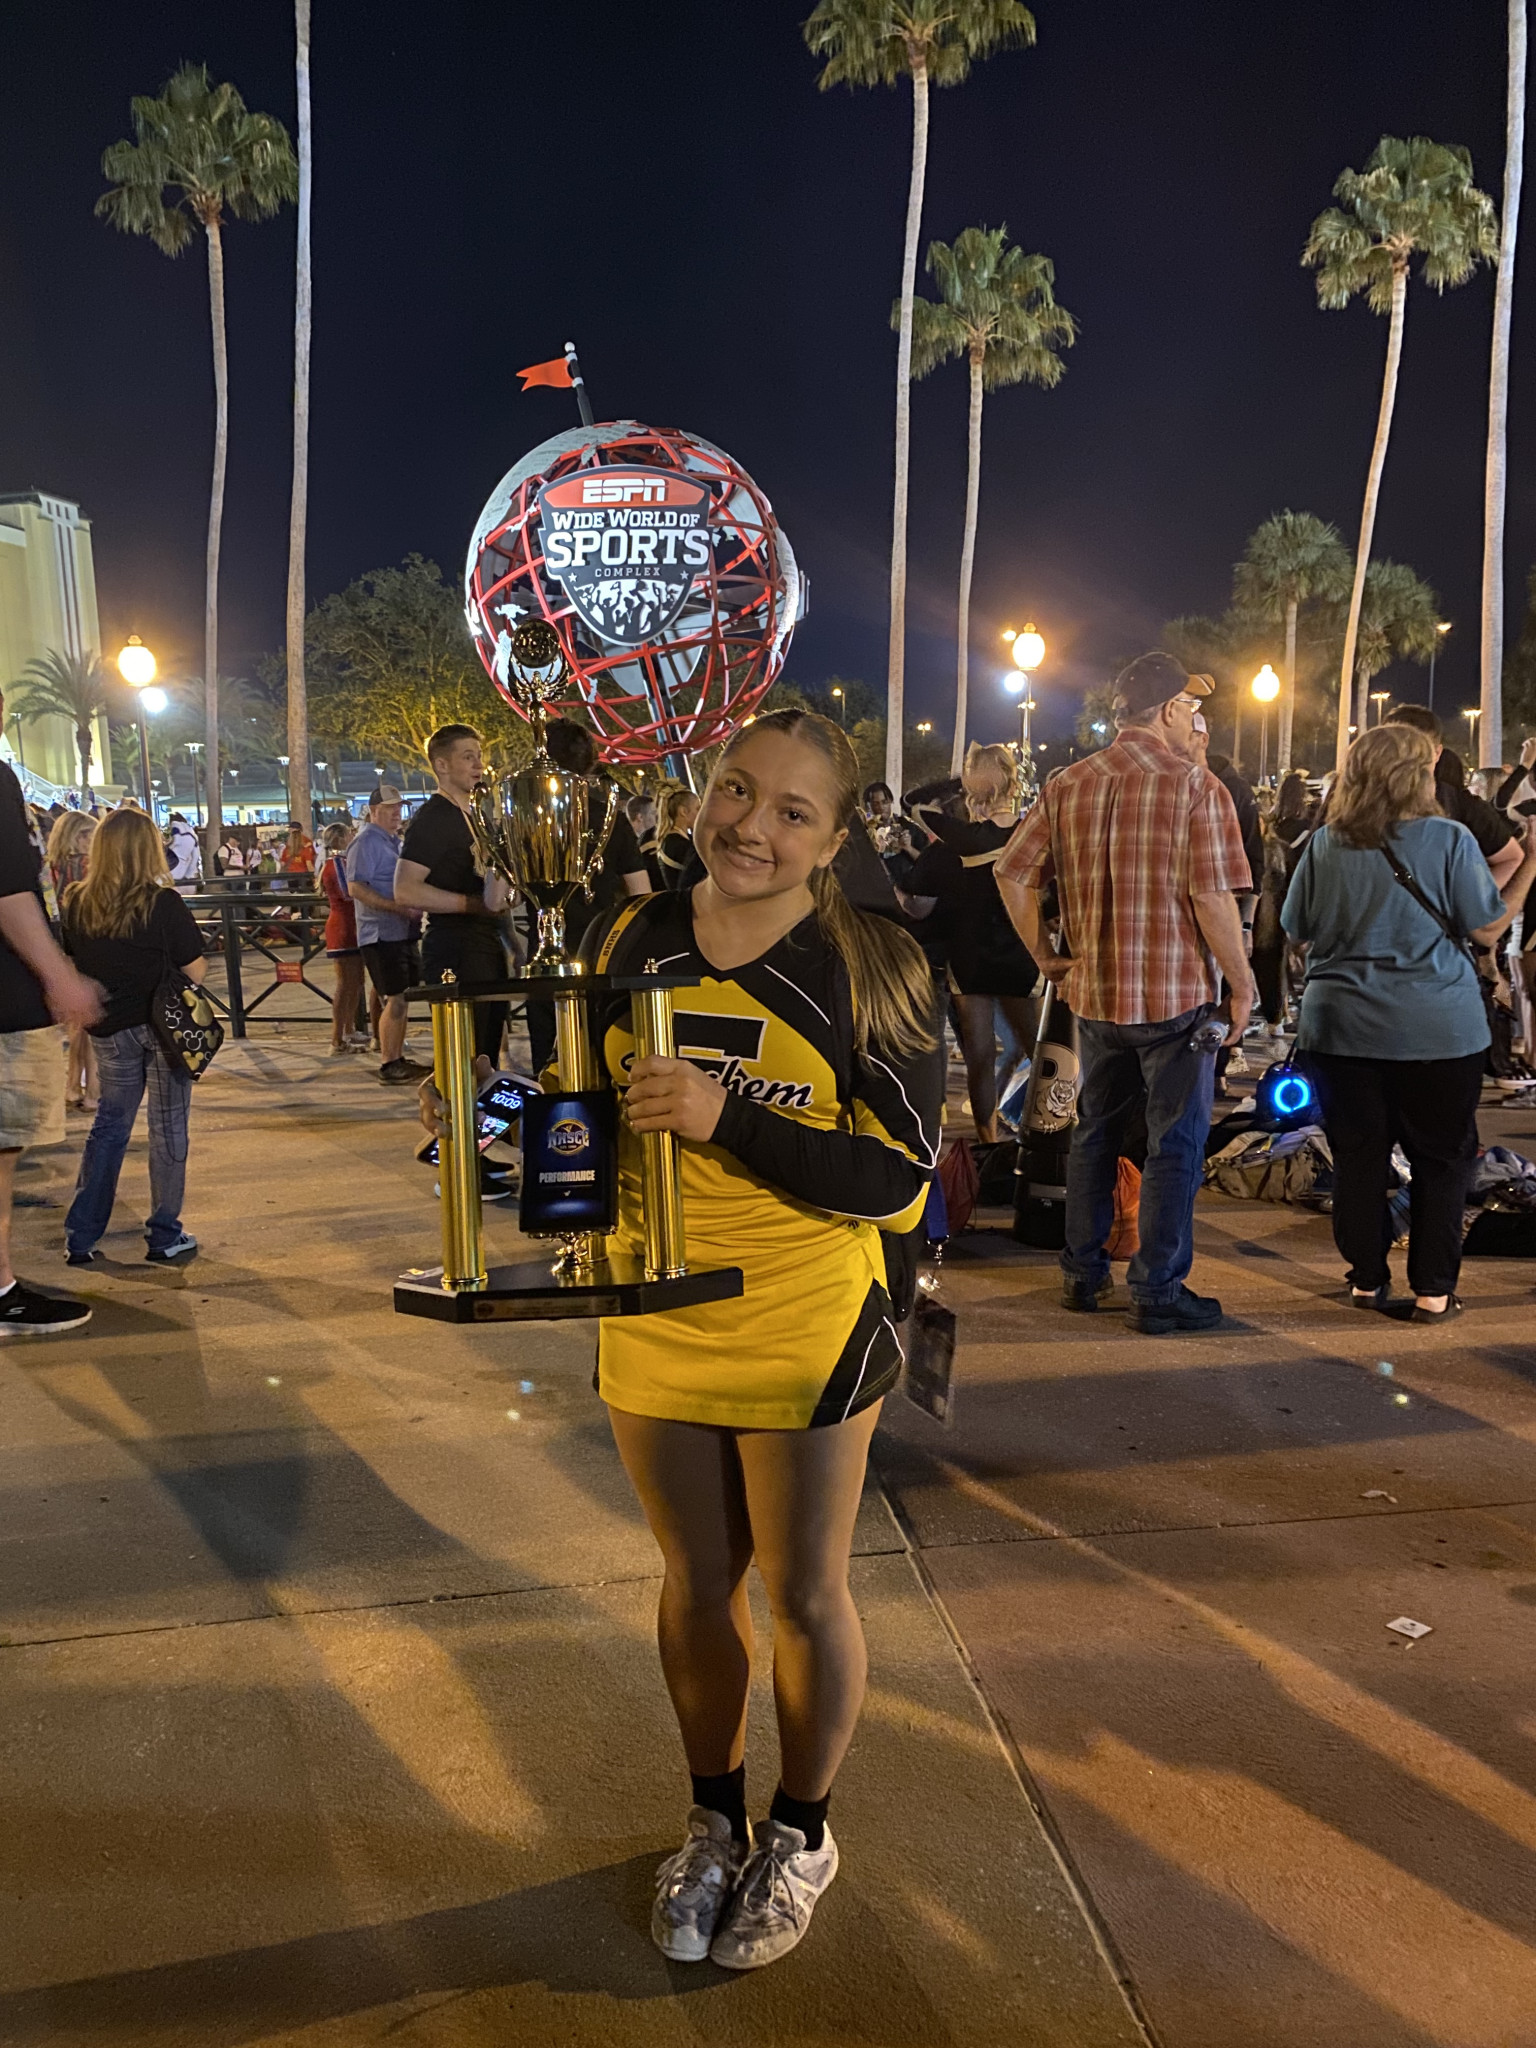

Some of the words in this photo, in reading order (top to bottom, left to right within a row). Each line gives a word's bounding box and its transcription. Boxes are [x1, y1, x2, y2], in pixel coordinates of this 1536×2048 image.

[583, 479, 666, 504] ESPN
[552, 511, 604, 530] WIDE
[608, 509, 677, 528] WORLD
[680, 514, 700, 527] OF
[547, 529, 710, 569] SPORTS
[595, 567, 661, 577] COMPLEX
[491, 1092, 521, 1109] 10:09
[539, 1170, 596, 1184] PERFORMANCE
